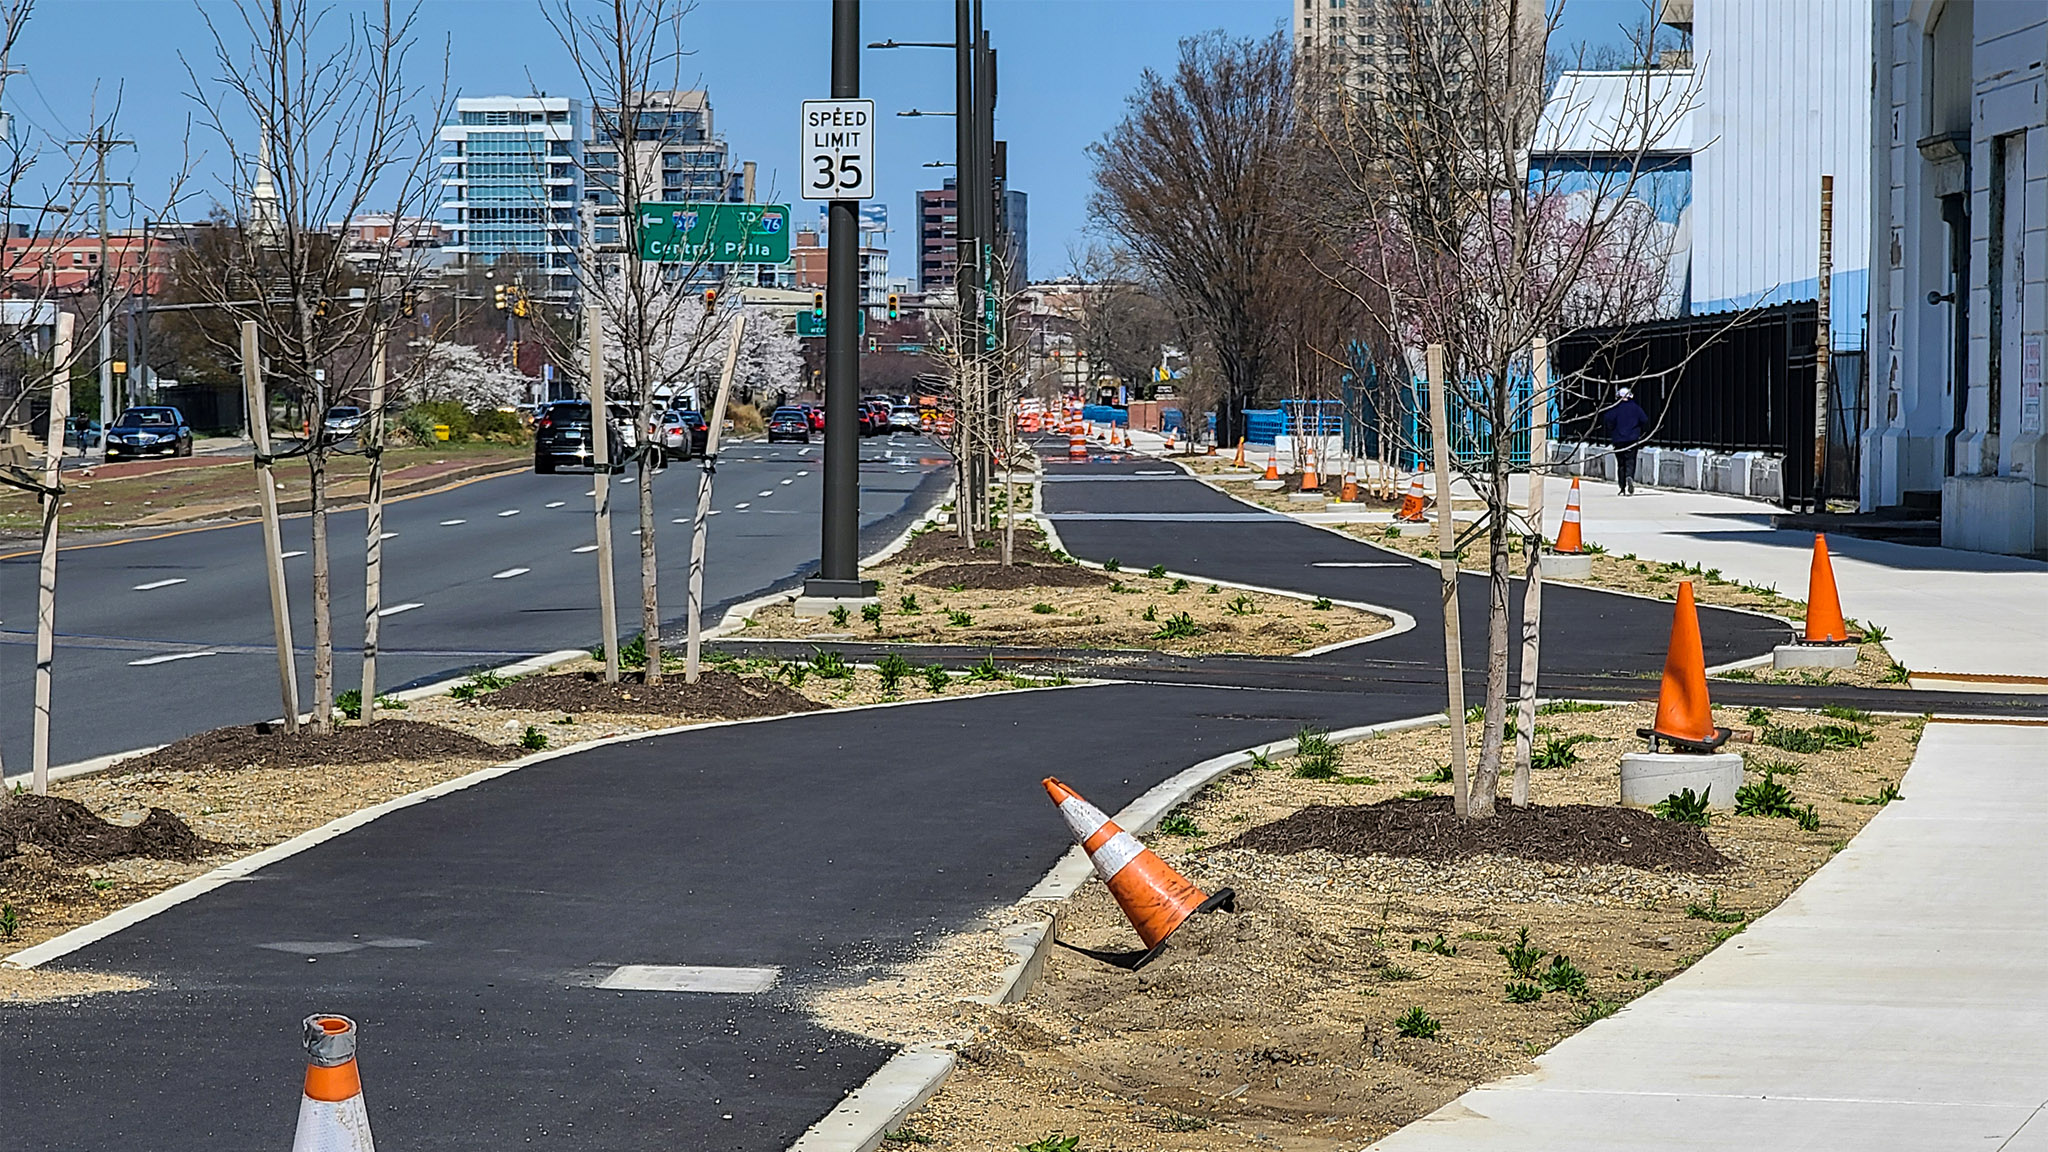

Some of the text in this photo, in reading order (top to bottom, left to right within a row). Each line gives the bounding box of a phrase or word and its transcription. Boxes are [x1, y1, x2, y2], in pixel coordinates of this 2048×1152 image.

[809, 111, 867, 127] SPEED
[814, 132, 861, 147] LIMIT
[812, 155, 862, 189] 35
[739, 211, 780, 230] TO 76
